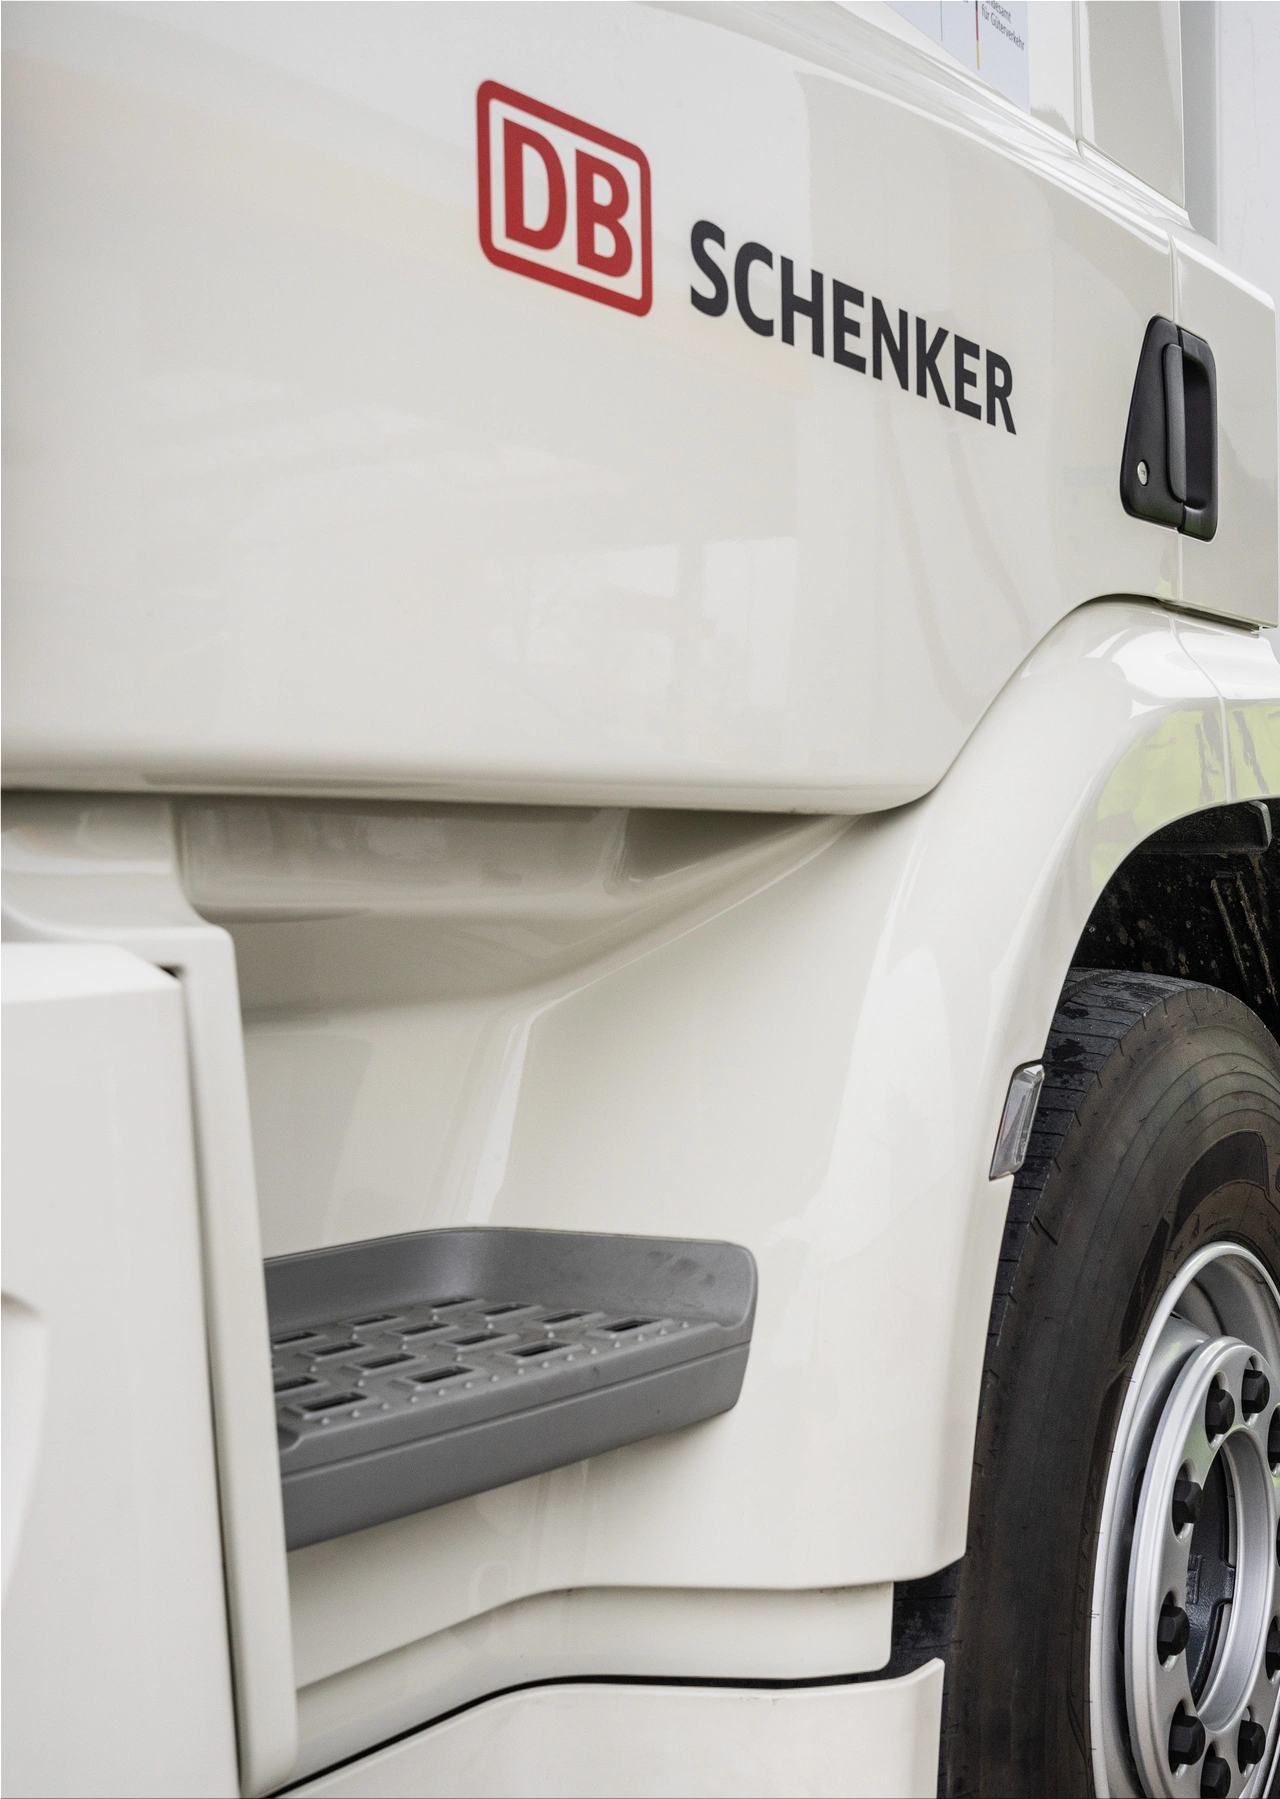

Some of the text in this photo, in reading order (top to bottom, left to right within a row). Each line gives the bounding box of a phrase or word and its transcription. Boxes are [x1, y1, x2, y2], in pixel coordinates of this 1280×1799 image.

[981, 4, 1025, 51] für Güterverkehr
[503, 118, 1017, 436] DB SCHENKER
